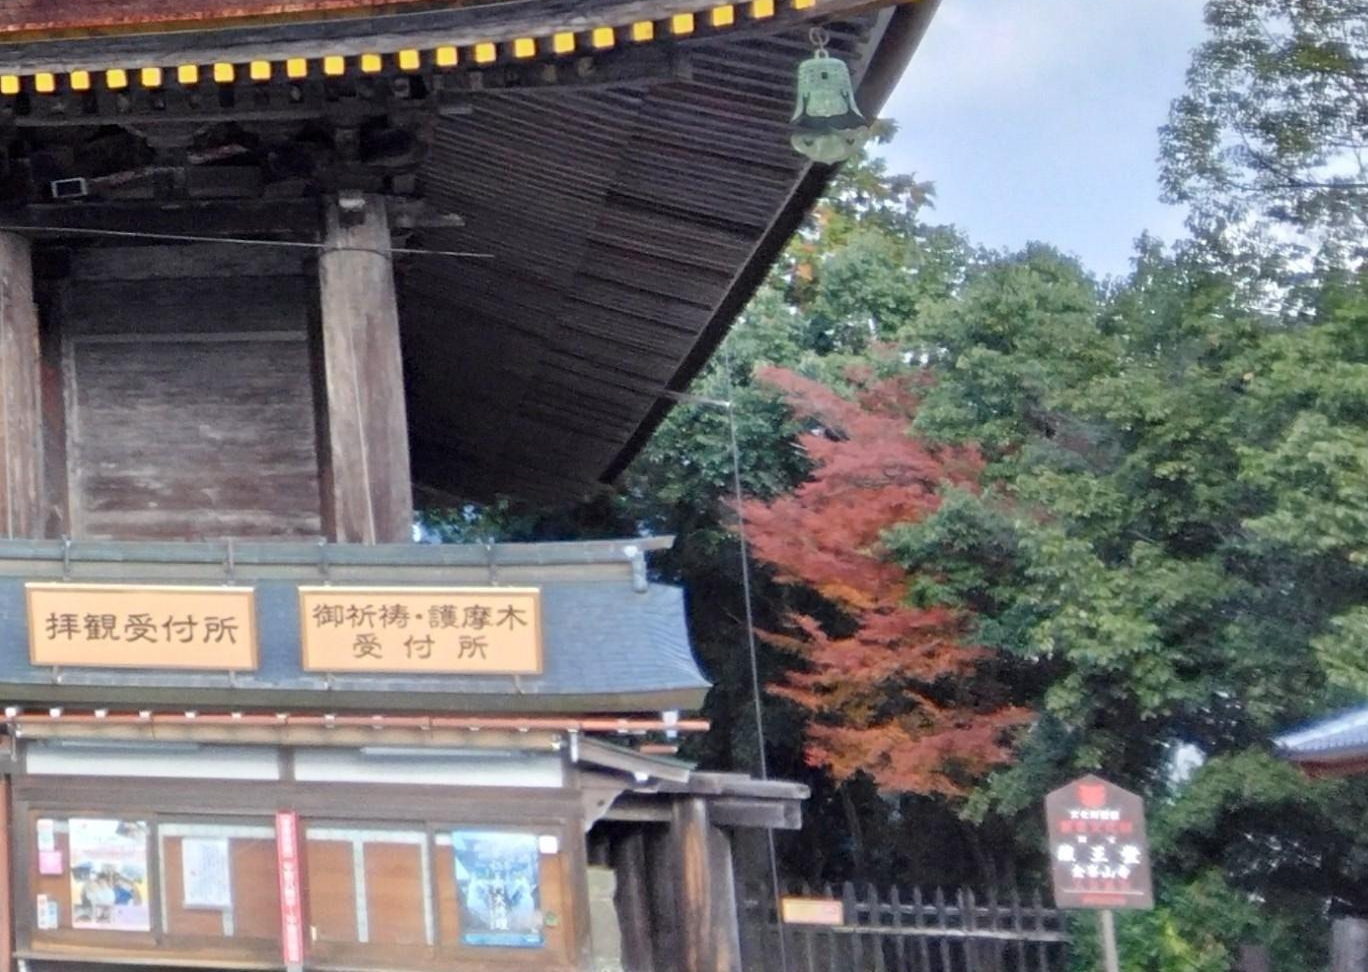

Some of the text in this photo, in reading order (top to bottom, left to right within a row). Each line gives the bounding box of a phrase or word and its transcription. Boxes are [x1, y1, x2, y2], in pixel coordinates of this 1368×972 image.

[44, 612, 239, 644] 拝観受付所
[311, 602, 530, 631] 御祈祷・護摩木
[352, 633, 490, 660] 受付所
